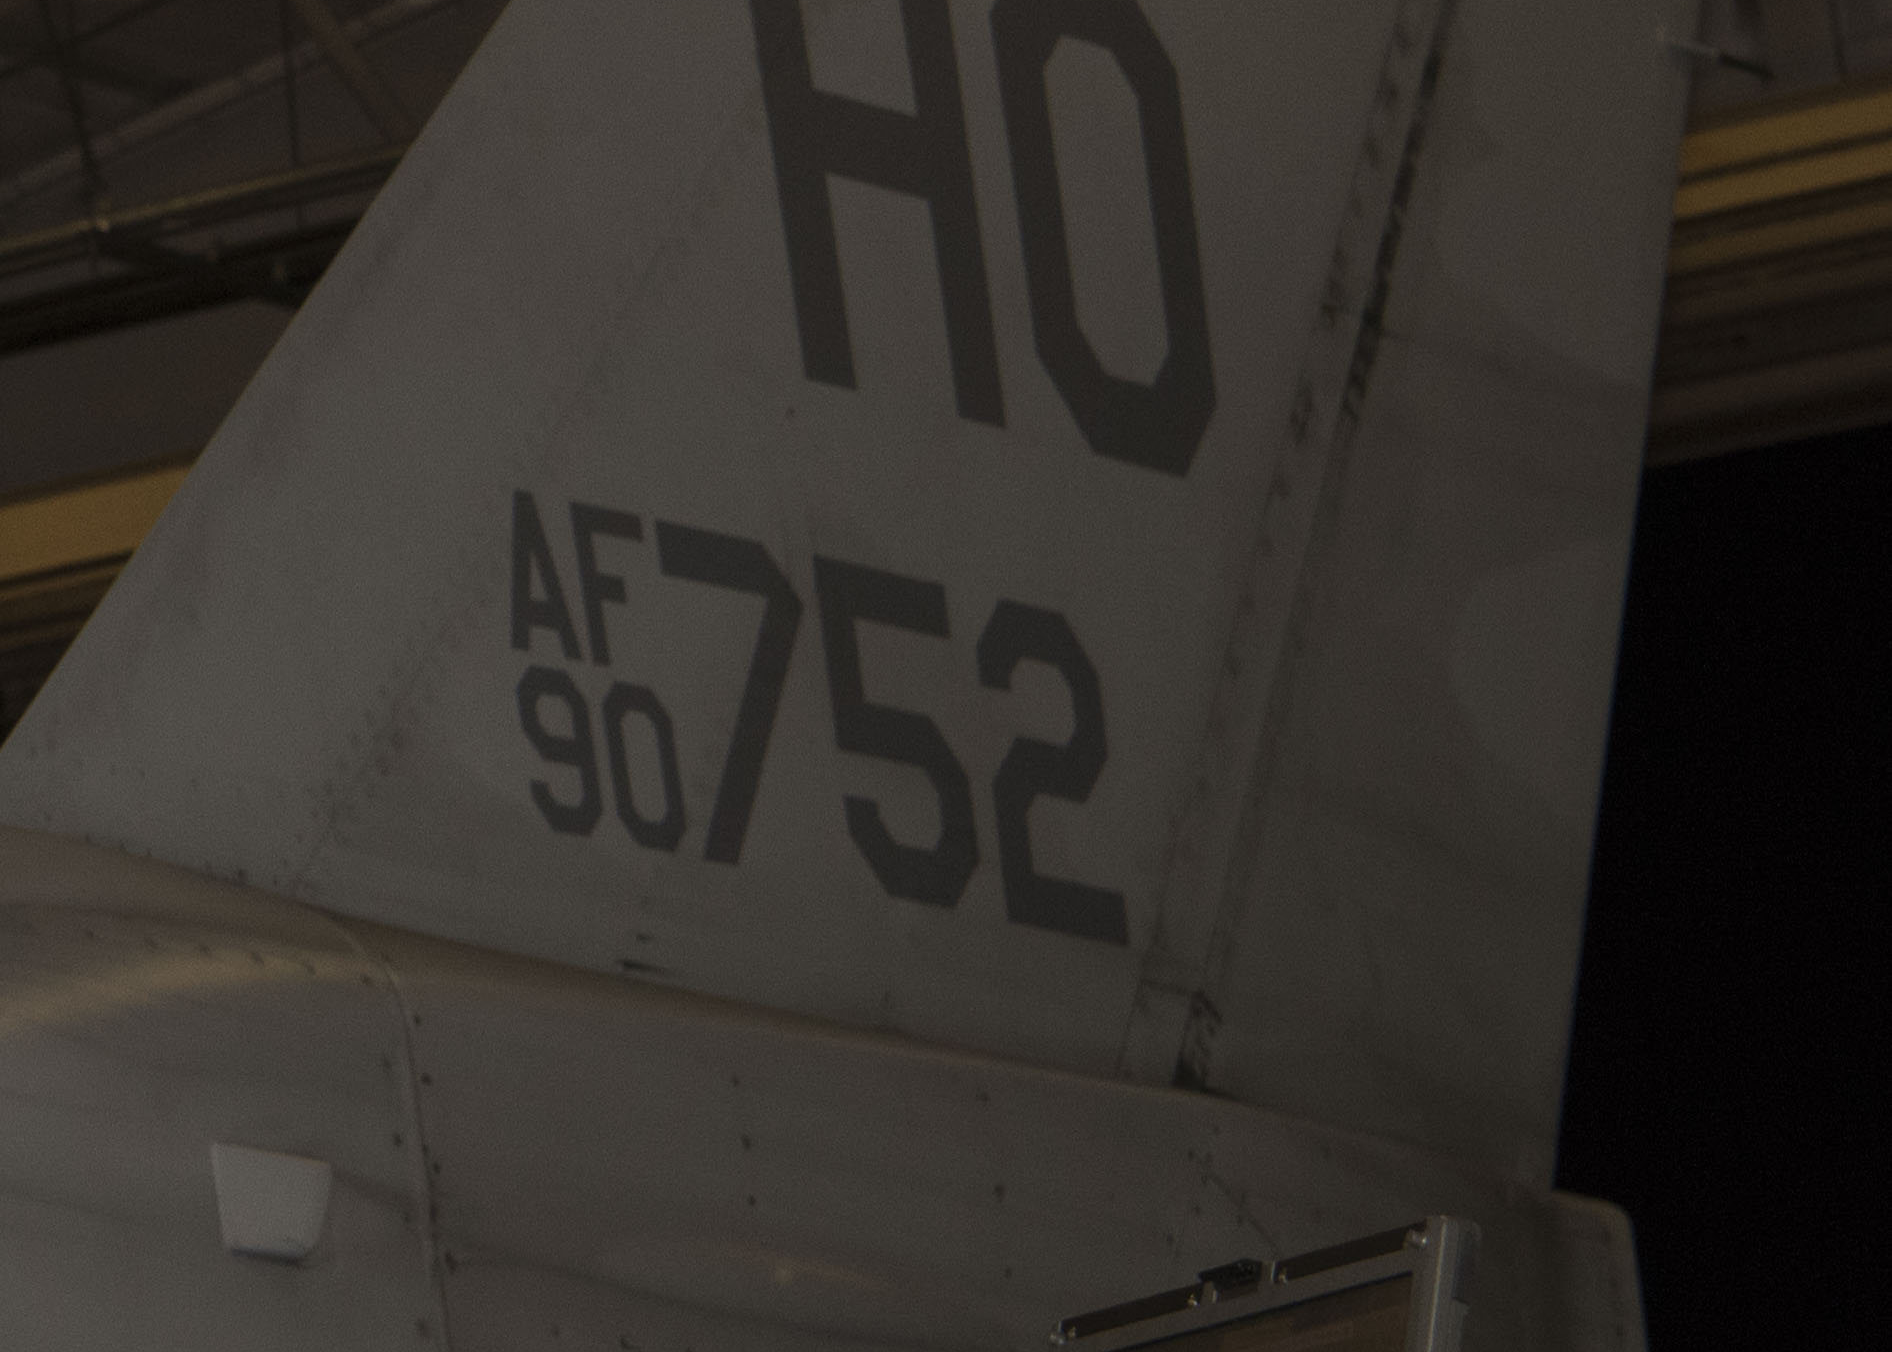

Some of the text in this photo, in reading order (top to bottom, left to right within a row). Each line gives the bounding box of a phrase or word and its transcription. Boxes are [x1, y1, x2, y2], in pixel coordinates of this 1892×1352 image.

[509, 487, 645, 667] AF
[514, 662, 688, 854] 90
[653, 515, 1132, 950] 752
